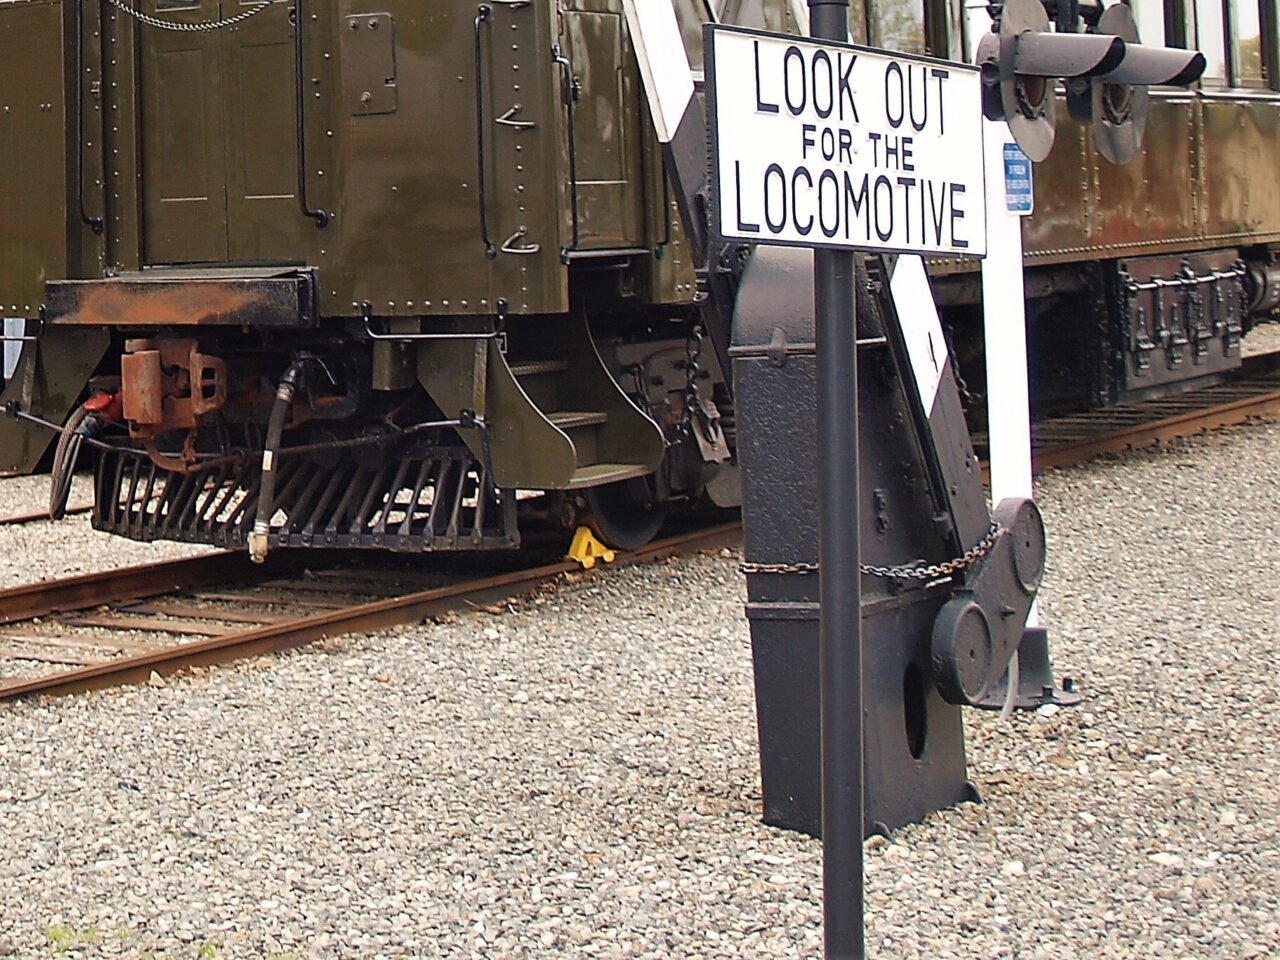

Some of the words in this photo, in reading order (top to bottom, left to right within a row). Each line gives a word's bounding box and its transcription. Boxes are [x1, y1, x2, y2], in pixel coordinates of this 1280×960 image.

[753, 40, 859, 123] LOOK
[885, 61, 949, 135] OUT
[802, 124, 853, 164] FOR
[868, 132, 915, 172] THE
[735, 160, 969, 248] LOCOMOTIVE
